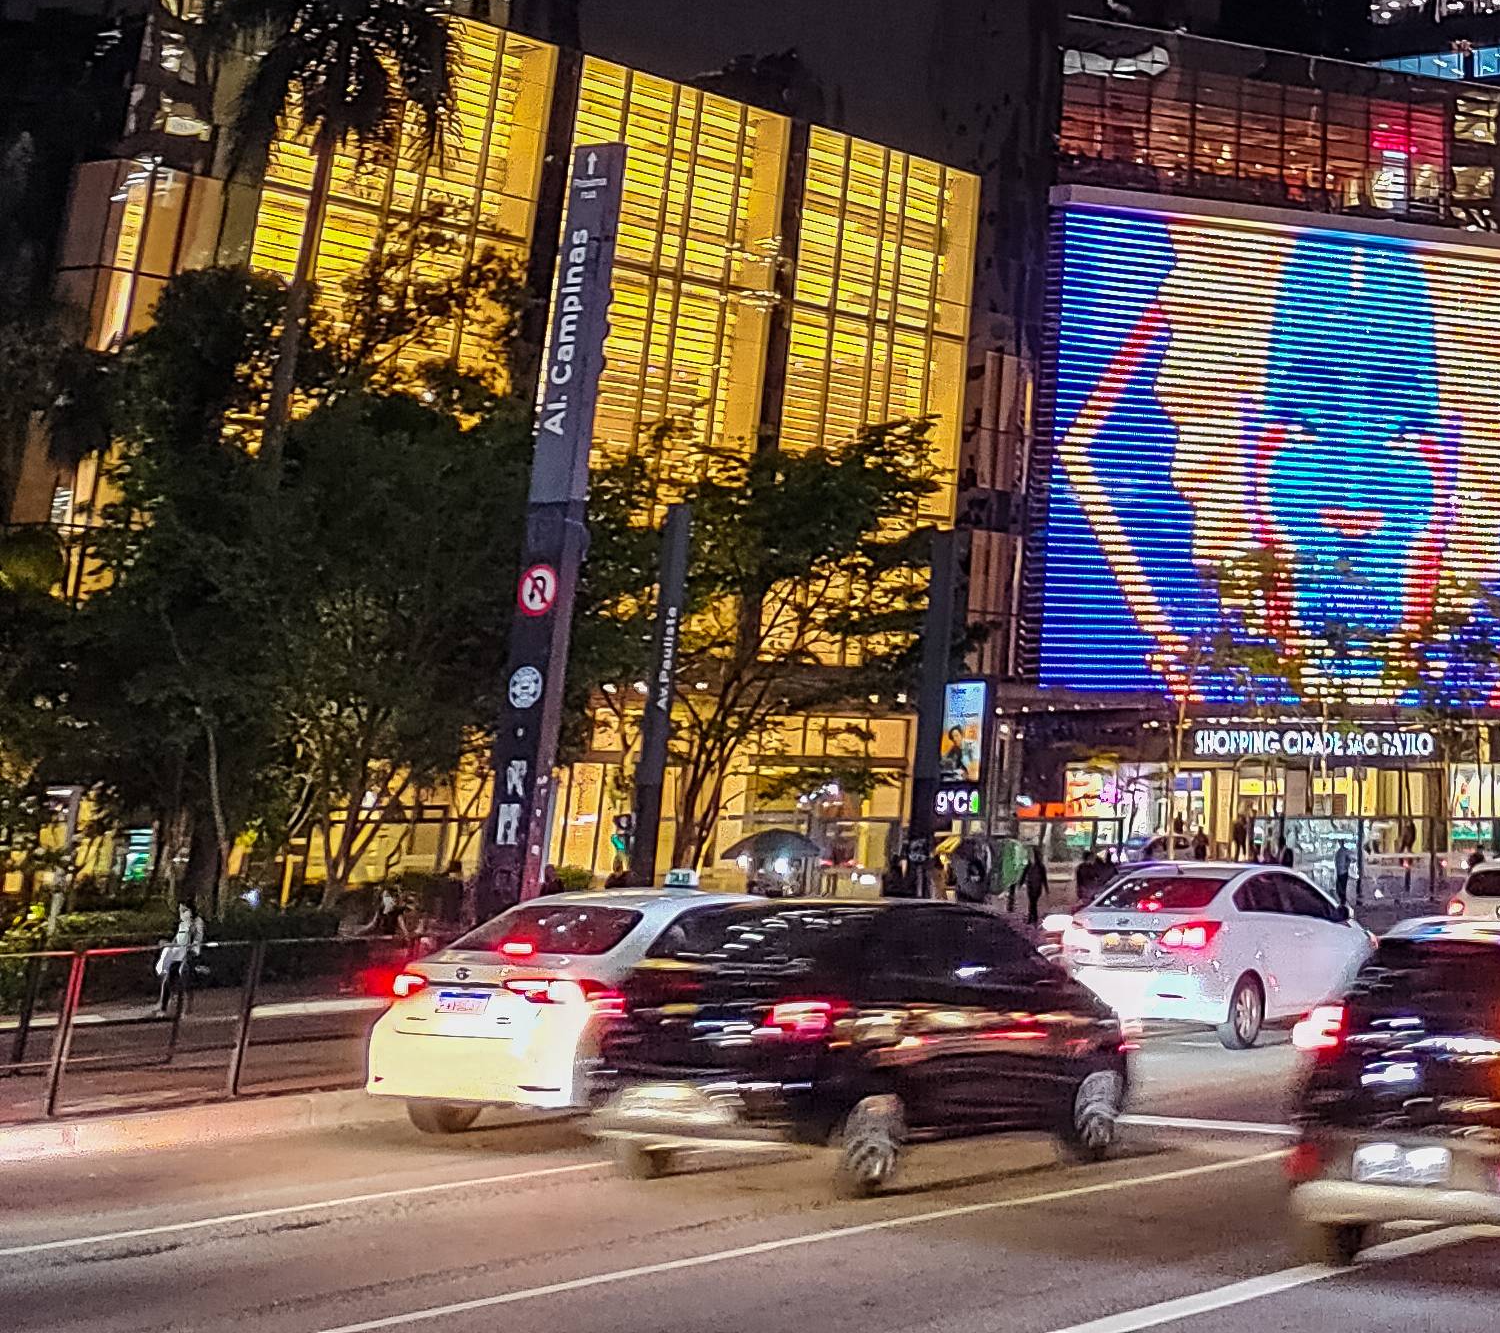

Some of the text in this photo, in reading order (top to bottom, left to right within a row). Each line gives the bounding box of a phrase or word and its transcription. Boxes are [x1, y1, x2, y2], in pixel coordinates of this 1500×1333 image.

[544, 229, 589, 435] Al. Campinas
[658, 607, 678, 683] Paulista
[1194, 729, 1281, 755] SHOPPING
[1281, 729, 1344, 756] CIDADE
